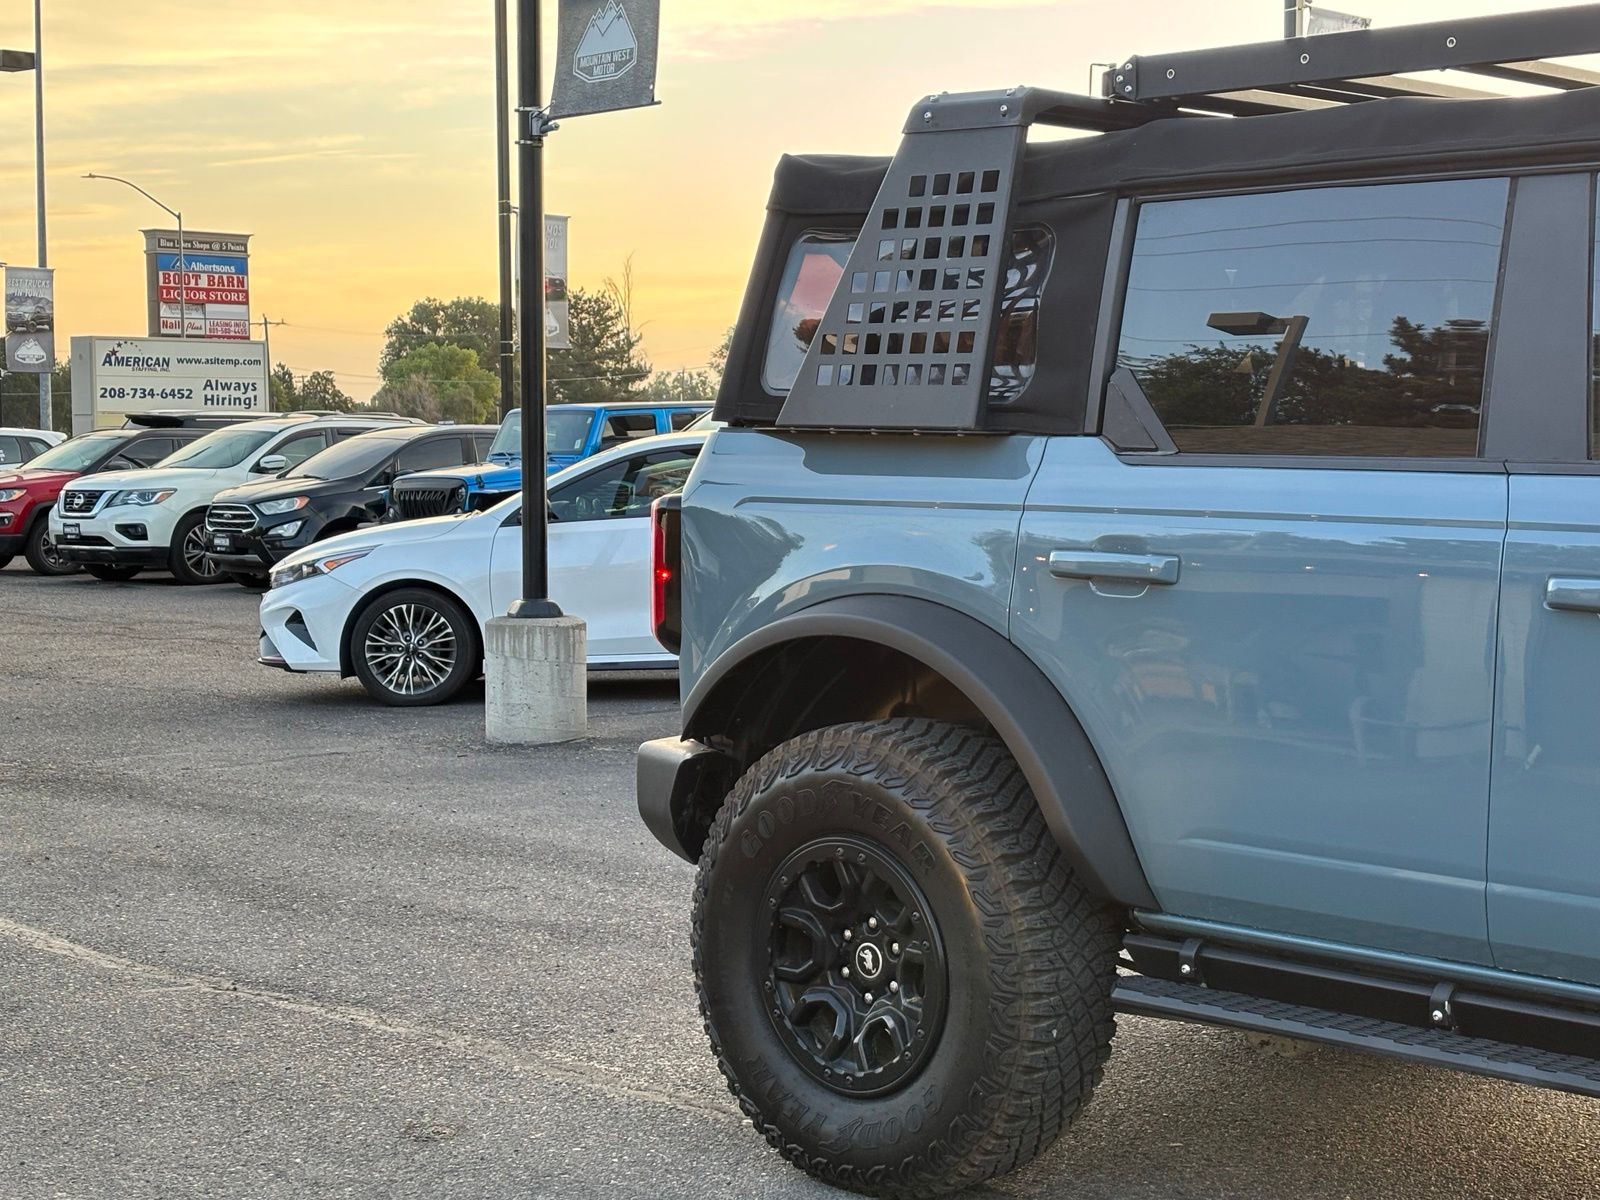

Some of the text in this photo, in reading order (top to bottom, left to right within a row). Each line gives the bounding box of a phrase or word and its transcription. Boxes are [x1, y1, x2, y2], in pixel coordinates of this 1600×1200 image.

[580, 49, 630, 68] MOUNTAIN WEST
[592, 63, 616, 76] MOTOR
[160, 238, 245, 251] Blue Lkes Shops @ 5 Points
[190, 262, 236, 273] Albertsons
[162, 272, 245, 289] BOOT BARN
[162, 289, 246, 302] LIQUOR STORE
[161, 319, 181, 330] Nail
[208, 320, 247, 329] LEASING INFO
[203, 379, 258, 394] Always
[100, 387, 193, 400] 208-734-6452
[203, 394, 258, 410] Hiring!
